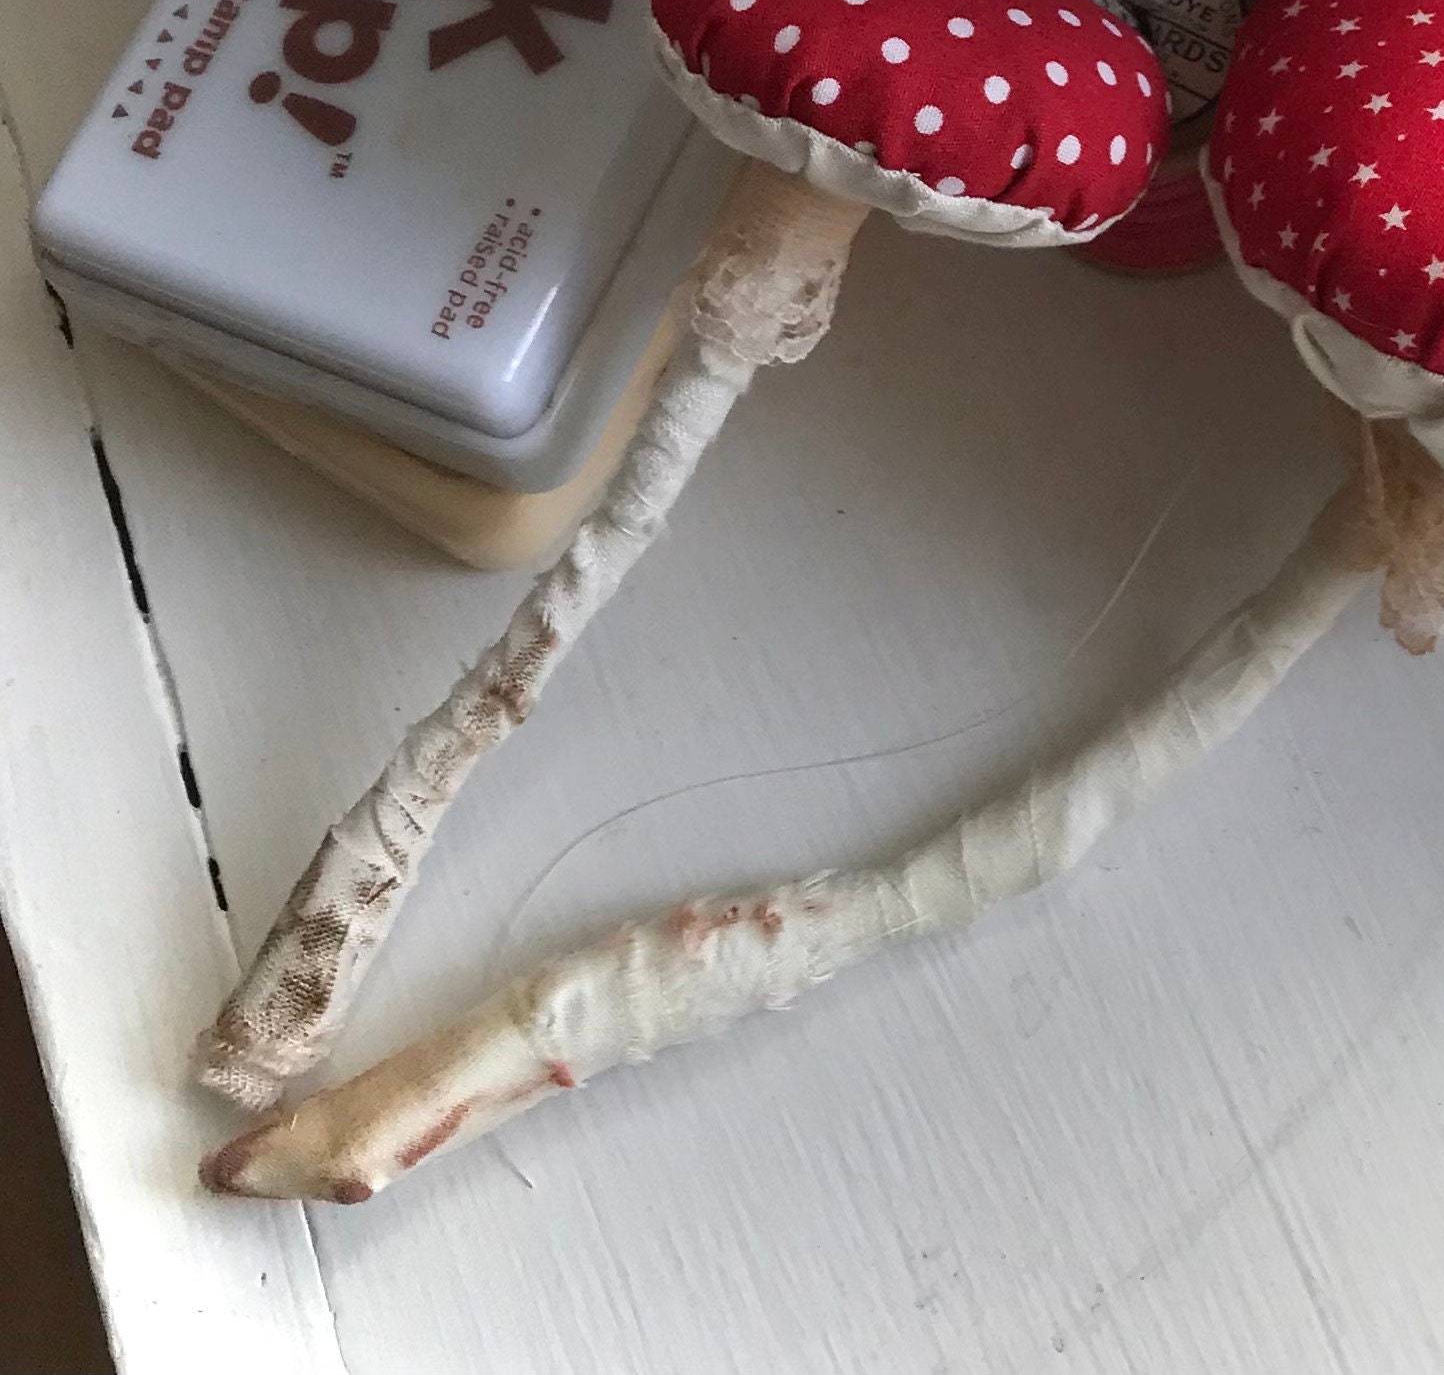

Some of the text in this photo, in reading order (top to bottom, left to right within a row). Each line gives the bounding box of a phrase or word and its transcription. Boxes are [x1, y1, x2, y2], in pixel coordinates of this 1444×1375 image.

[131, 81, 192, 160] pad
[431, 212, 510, 341] raised pad
[465, 222, 534, 330] acid-free
